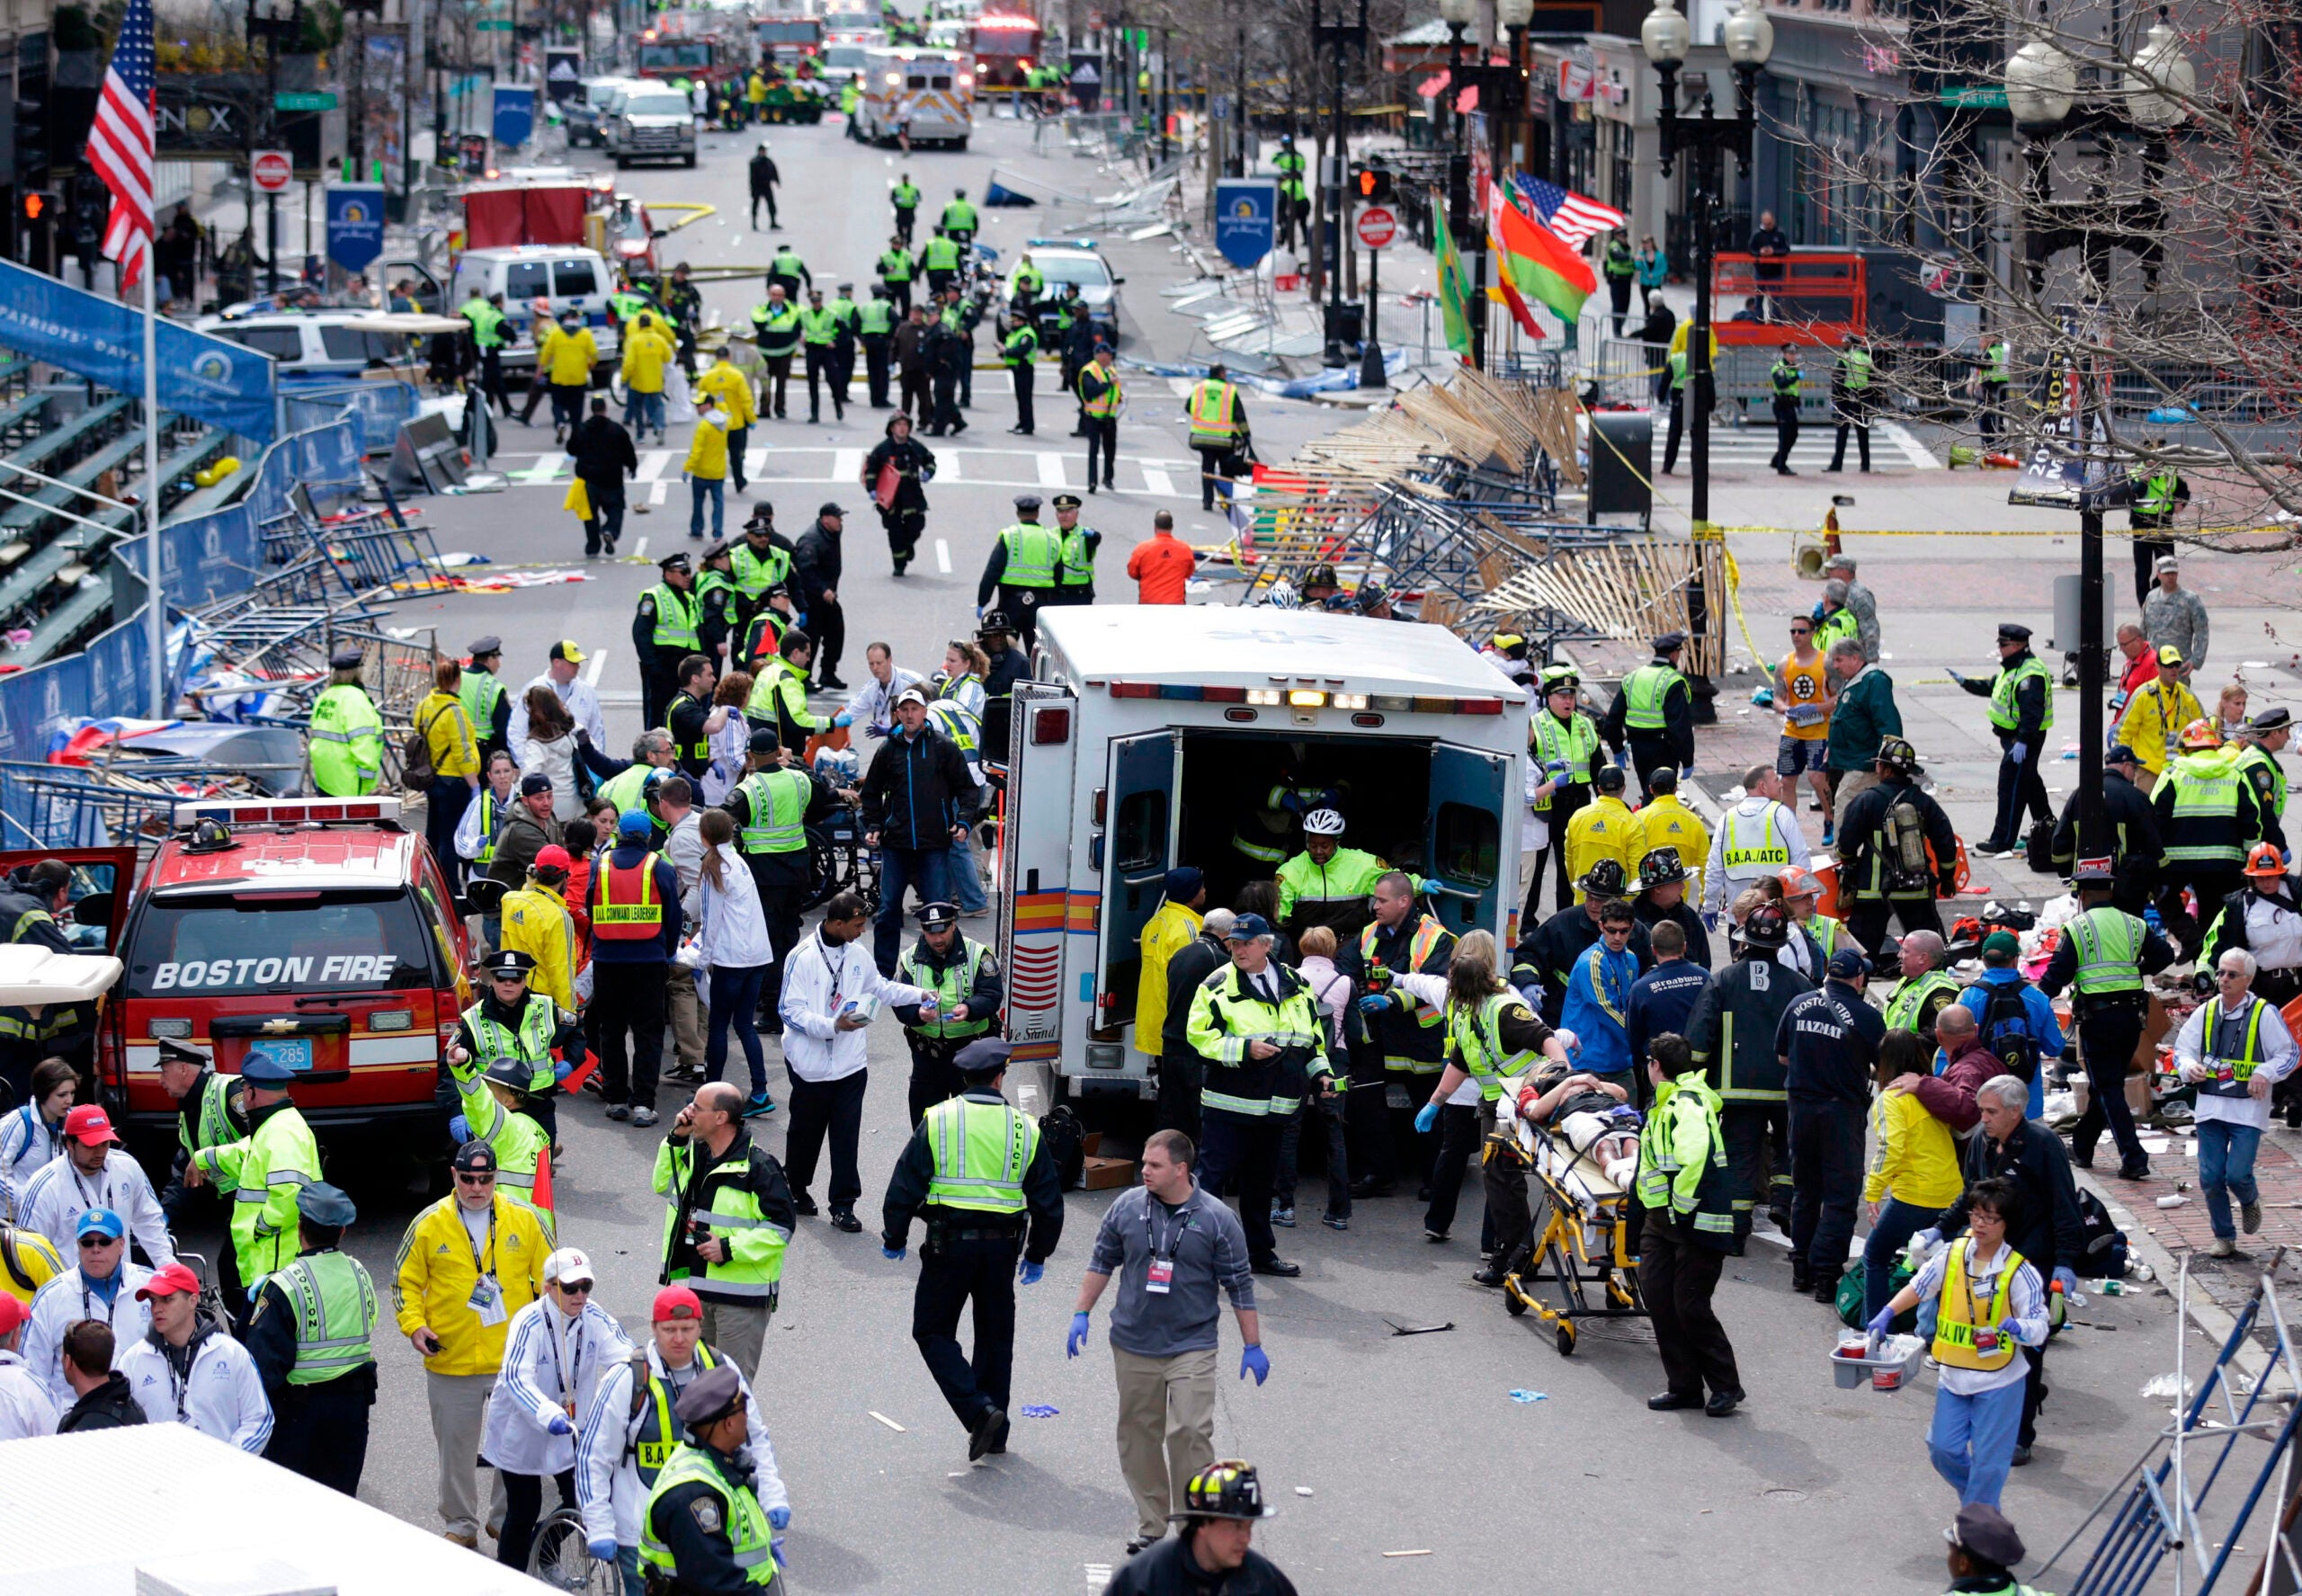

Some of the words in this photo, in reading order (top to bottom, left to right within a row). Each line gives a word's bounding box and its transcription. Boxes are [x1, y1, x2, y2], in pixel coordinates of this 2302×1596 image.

[2029, 422, 2056, 476] 203
[755, 784, 769, 824] BOSTON
[1672, 857, 1682, 871] 2
[1726, 850, 1784, 865] B.A.A./ATC
[606, 906, 629, 922] COMMAND
[630, 905, 658, 921] LEADERSHIP
[151, 957, 314, 990] BOSTON
[319, 955, 397, 983] FIRE
[1648, 976, 1704, 993] Broadway
[1022, 1024, 1057, 1041] Stand
[1795, 1019, 1844, 1040] HAZMAT
[280, 1048, 305, 1065] 285
[1012, 1113, 1023, 1171] POLICE
[292, 1268, 318, 1329] BOSTON
[358, 1266, 374, 1320] OLICE
[1953, 1325, 1967, 1344] IV
[1244, 1481, 1257, 1504] 7
